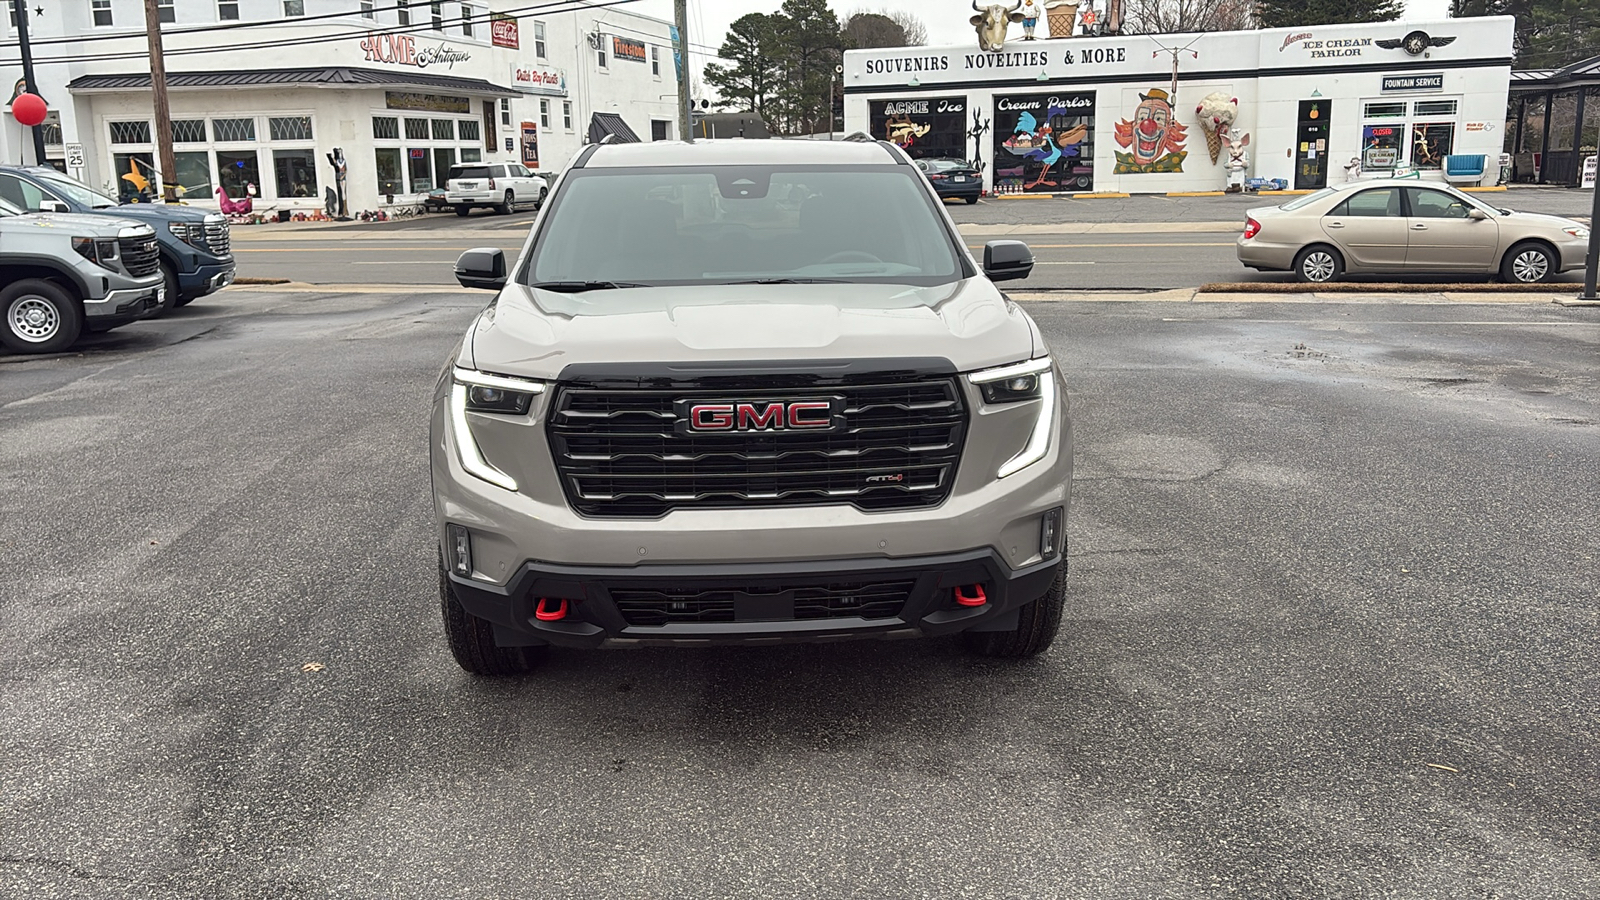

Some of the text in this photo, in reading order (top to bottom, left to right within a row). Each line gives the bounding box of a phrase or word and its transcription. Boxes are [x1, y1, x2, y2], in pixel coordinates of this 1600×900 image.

[1303, 38, 1372, 49] ICE CREAM
[360, 32, 417, 66] ACME
[428, 41, 471, 70] Antiques
[1311, 49, 1361, 58] PARLOR
[866, 48, 1126, 74] SOUVENIRS NOVELTIES & MORE
[516, 69, 559, 86] Dutch Boy Paints
[1384, 77, 1441, 88] FOUNTAIN SERVICE
[885, 100, 964, 115] ACME Ice
[998, 96, 1092, 111] Cream Parlor
[1372, 128, 1393, 136] CLOSED
[70, 155, 83, 165] 25
[525, 148, 537, 160] TEA
[691, 402, 830, 430] GMC
[866, 474, 903, 483] AT4
